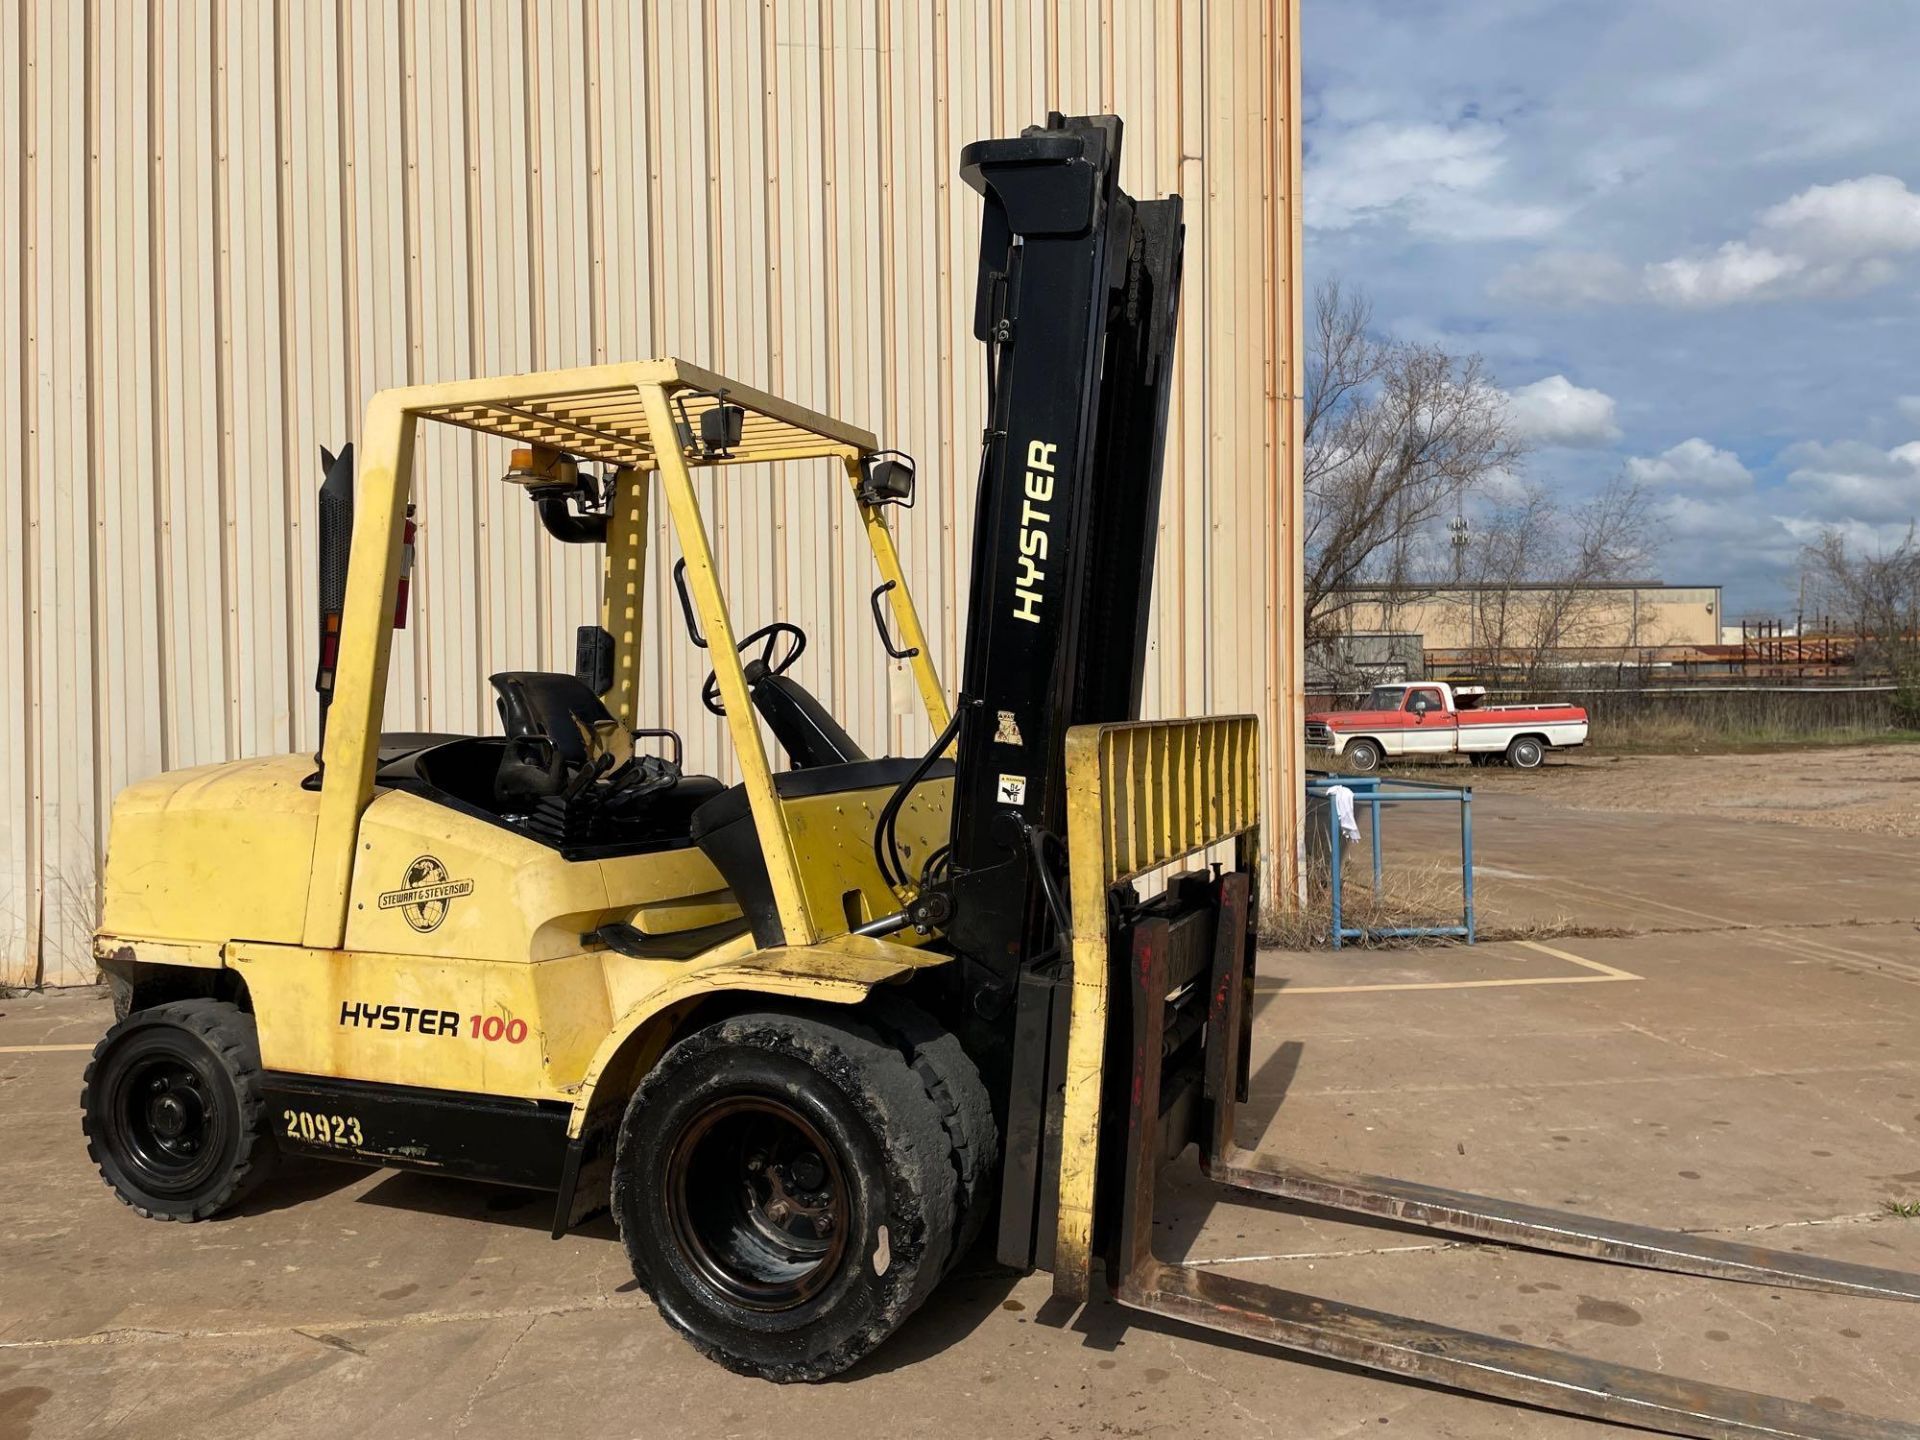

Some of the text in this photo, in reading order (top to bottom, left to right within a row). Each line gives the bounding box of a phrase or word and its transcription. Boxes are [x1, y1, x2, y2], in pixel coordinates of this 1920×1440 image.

[1013, 439, 1057, 624] HYSTER
[382, 882, 470, 906] STEWART & STEVENSON
[339, 1001, 528, 1044] HYSTER 100
[283, 1109, 364, 1146] 20923
